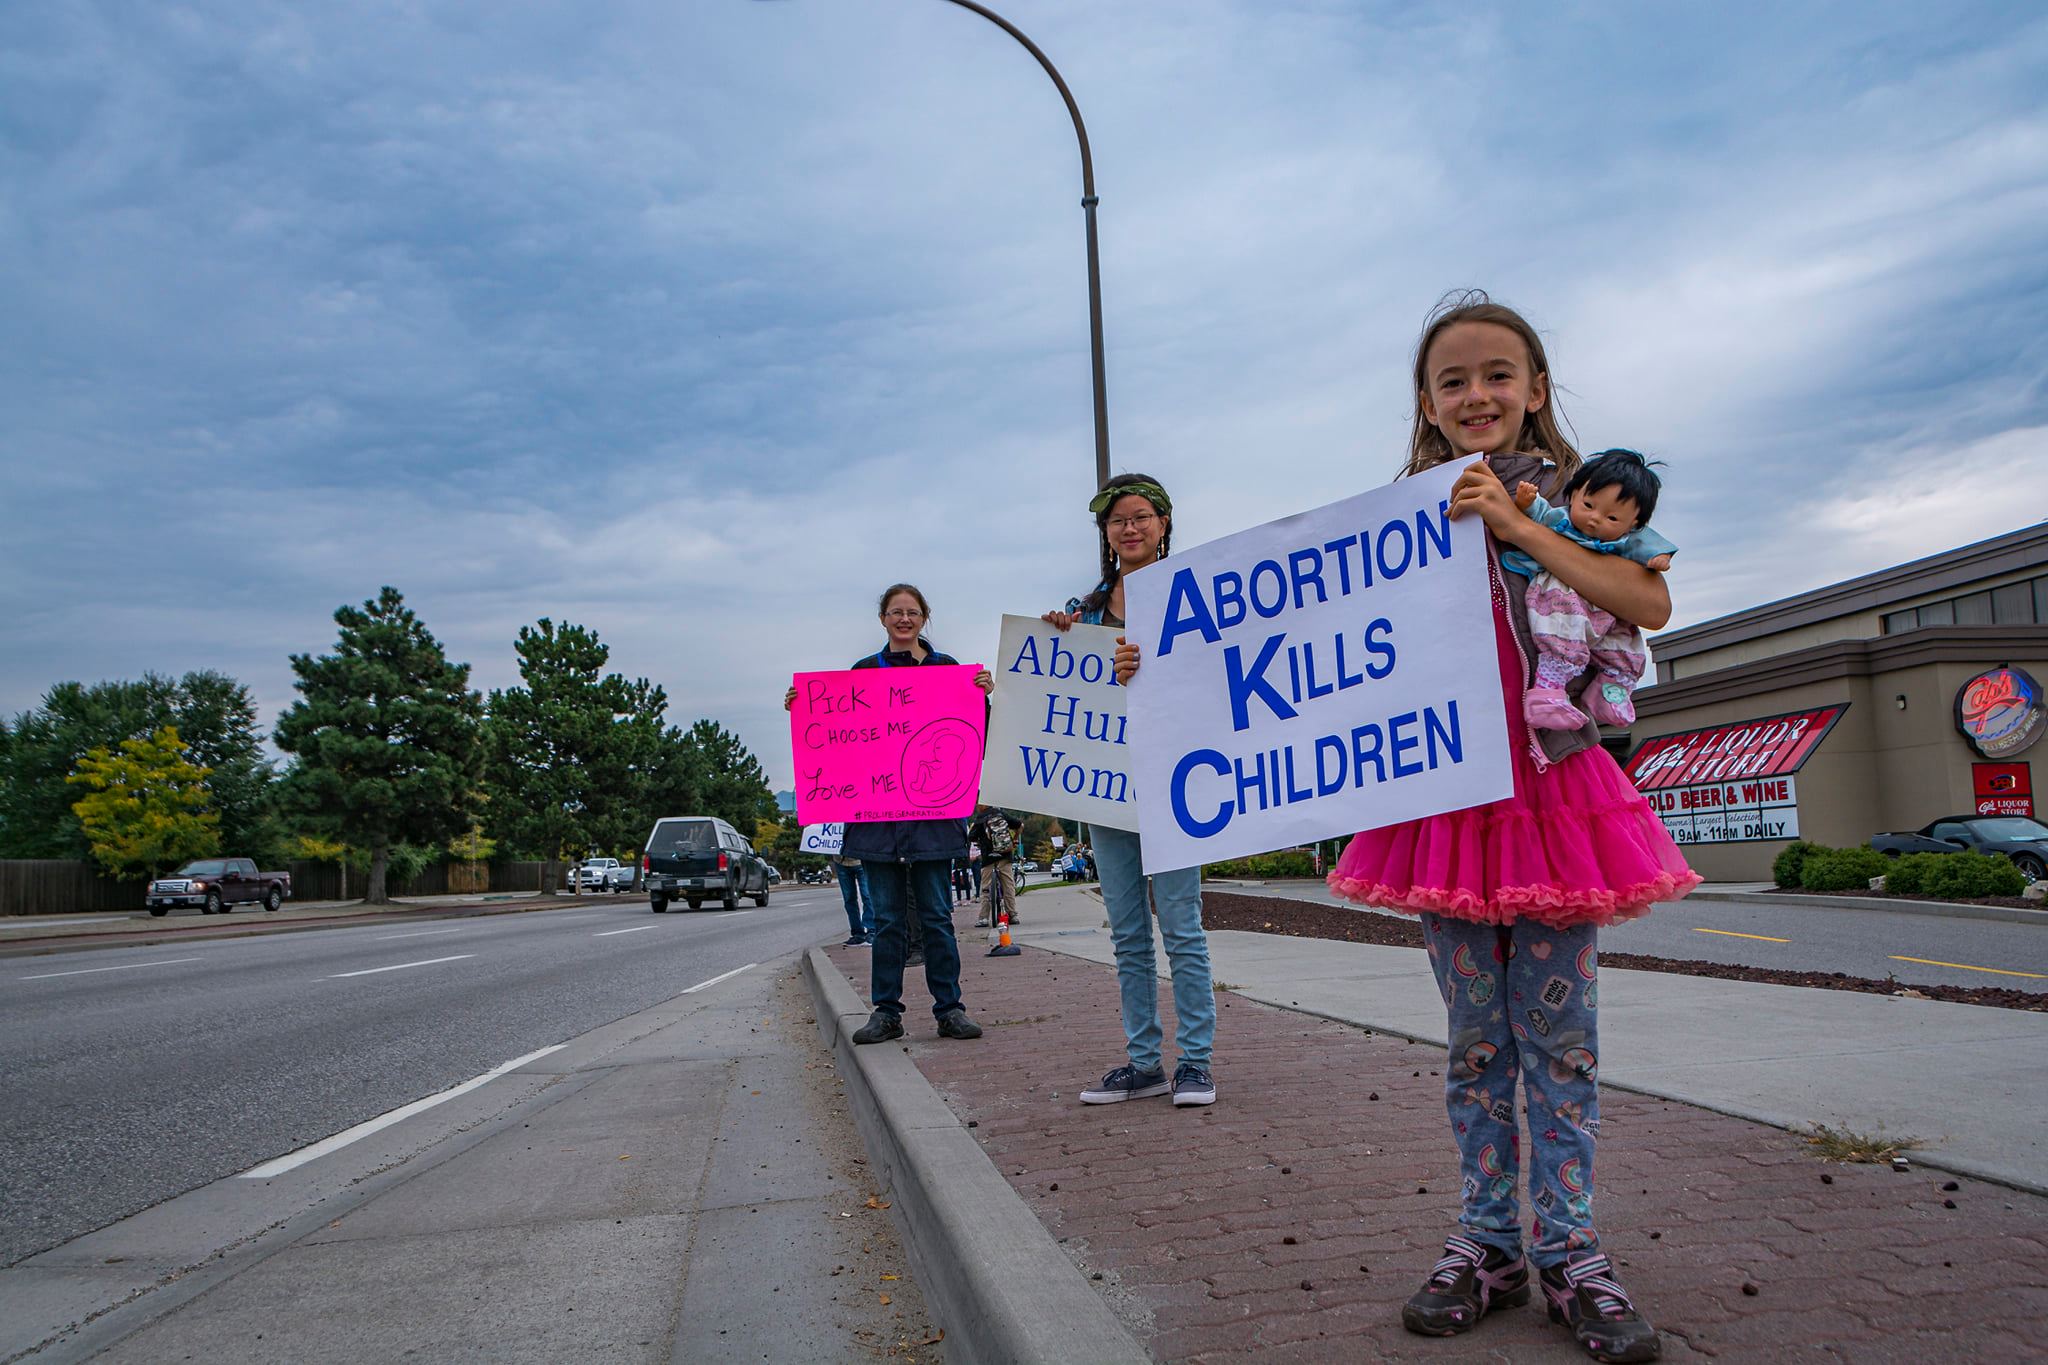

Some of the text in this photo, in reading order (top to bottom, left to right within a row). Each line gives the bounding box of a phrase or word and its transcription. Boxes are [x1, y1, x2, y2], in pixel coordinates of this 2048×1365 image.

[1156, 499, 1454, 657] ABORTION
[1223, 617, 1397, 732] KILLS
[807, 679, 916, 715] PICK ME
[804, 720, 913, 749] CHOOSE ME
[1699, 718, 1809, 755] LIQUOR
[1019, 745, 1137, 803] Wom
[1170, 700, 1464, 839] CHILDREN
[1681, 750, 1779, 782] STORE
[871, 773, 898, 794] ME
[1680, 787, 1722, 809] BEER
[1726, 786, 1738, 805] &
[1741, 780, 1789, 804] WINE
[1997, 800, 2029, 808] LIQUOR
[1695, 815, 1722, 828] Largest
[1744, 821, 1786, 838] DAILY
